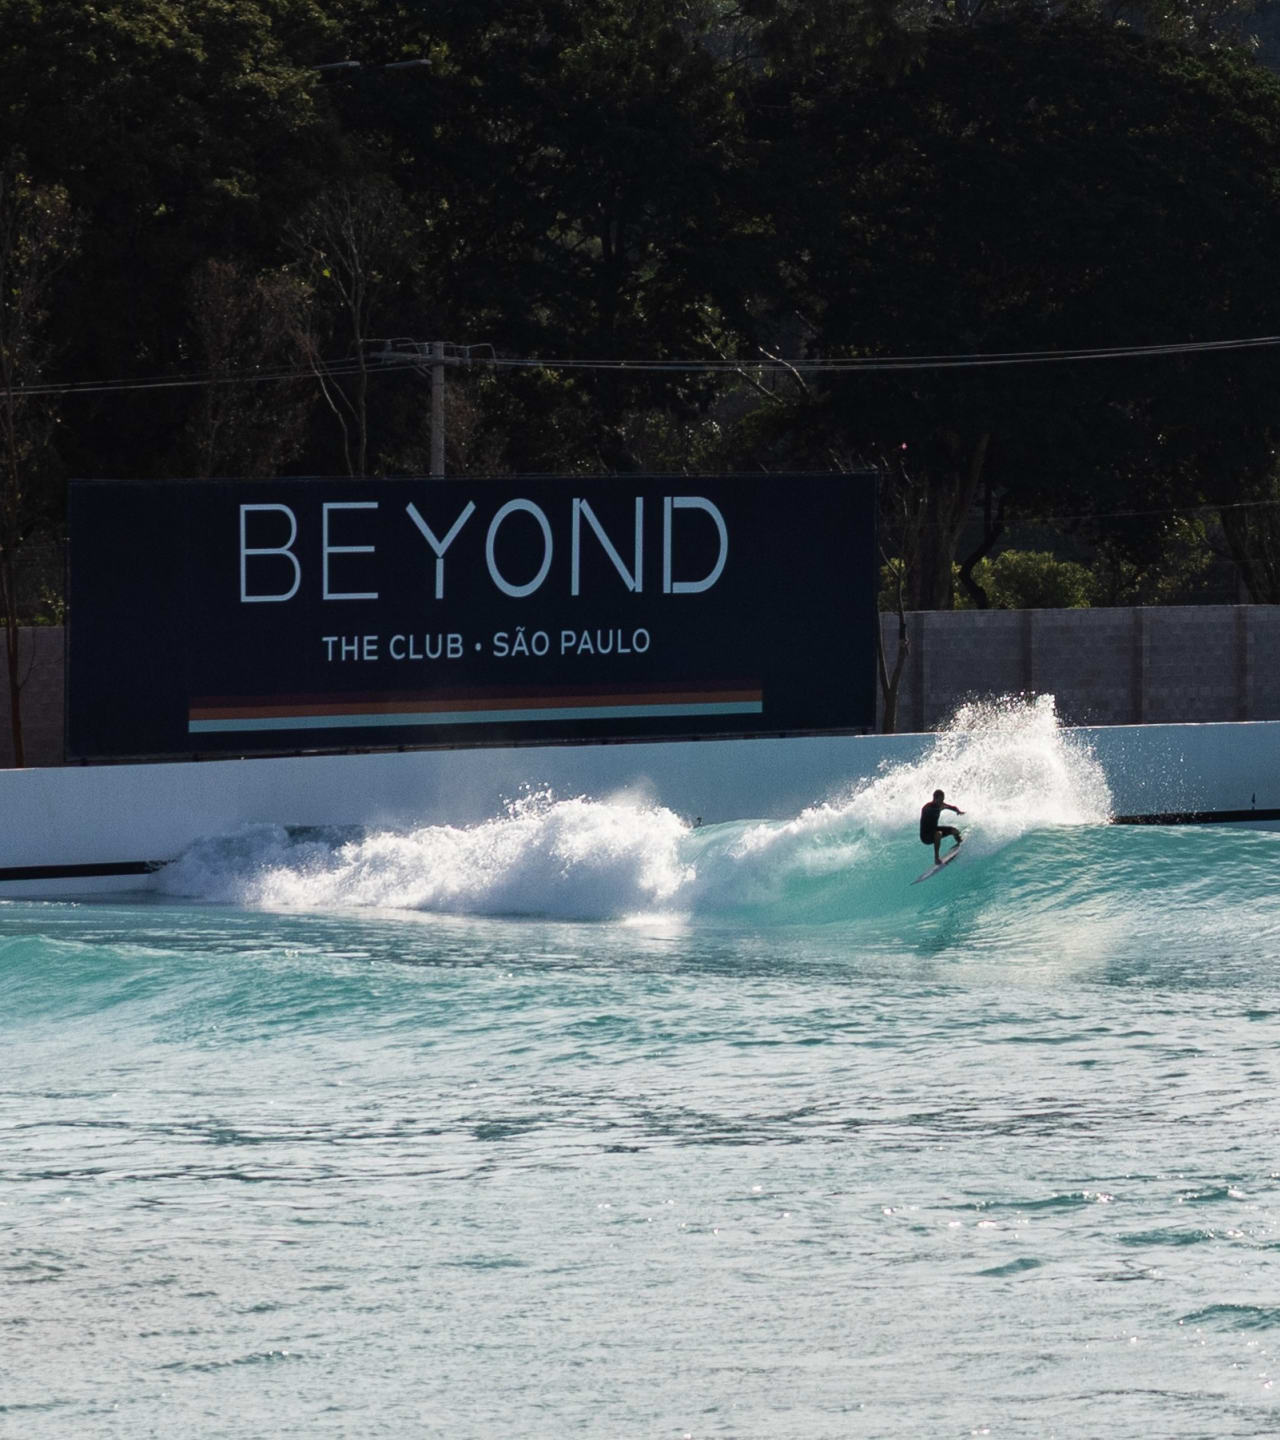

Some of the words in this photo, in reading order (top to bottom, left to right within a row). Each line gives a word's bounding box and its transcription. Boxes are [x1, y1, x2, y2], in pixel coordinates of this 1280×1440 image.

[239, 497, 728, 602] BEYOND
[322, 635, 379, 662] THE
[389, 633, 463, 660] CLUB
[493, 626, 550, 657] SÃO
[561, 628, 650, 655] PAULO
